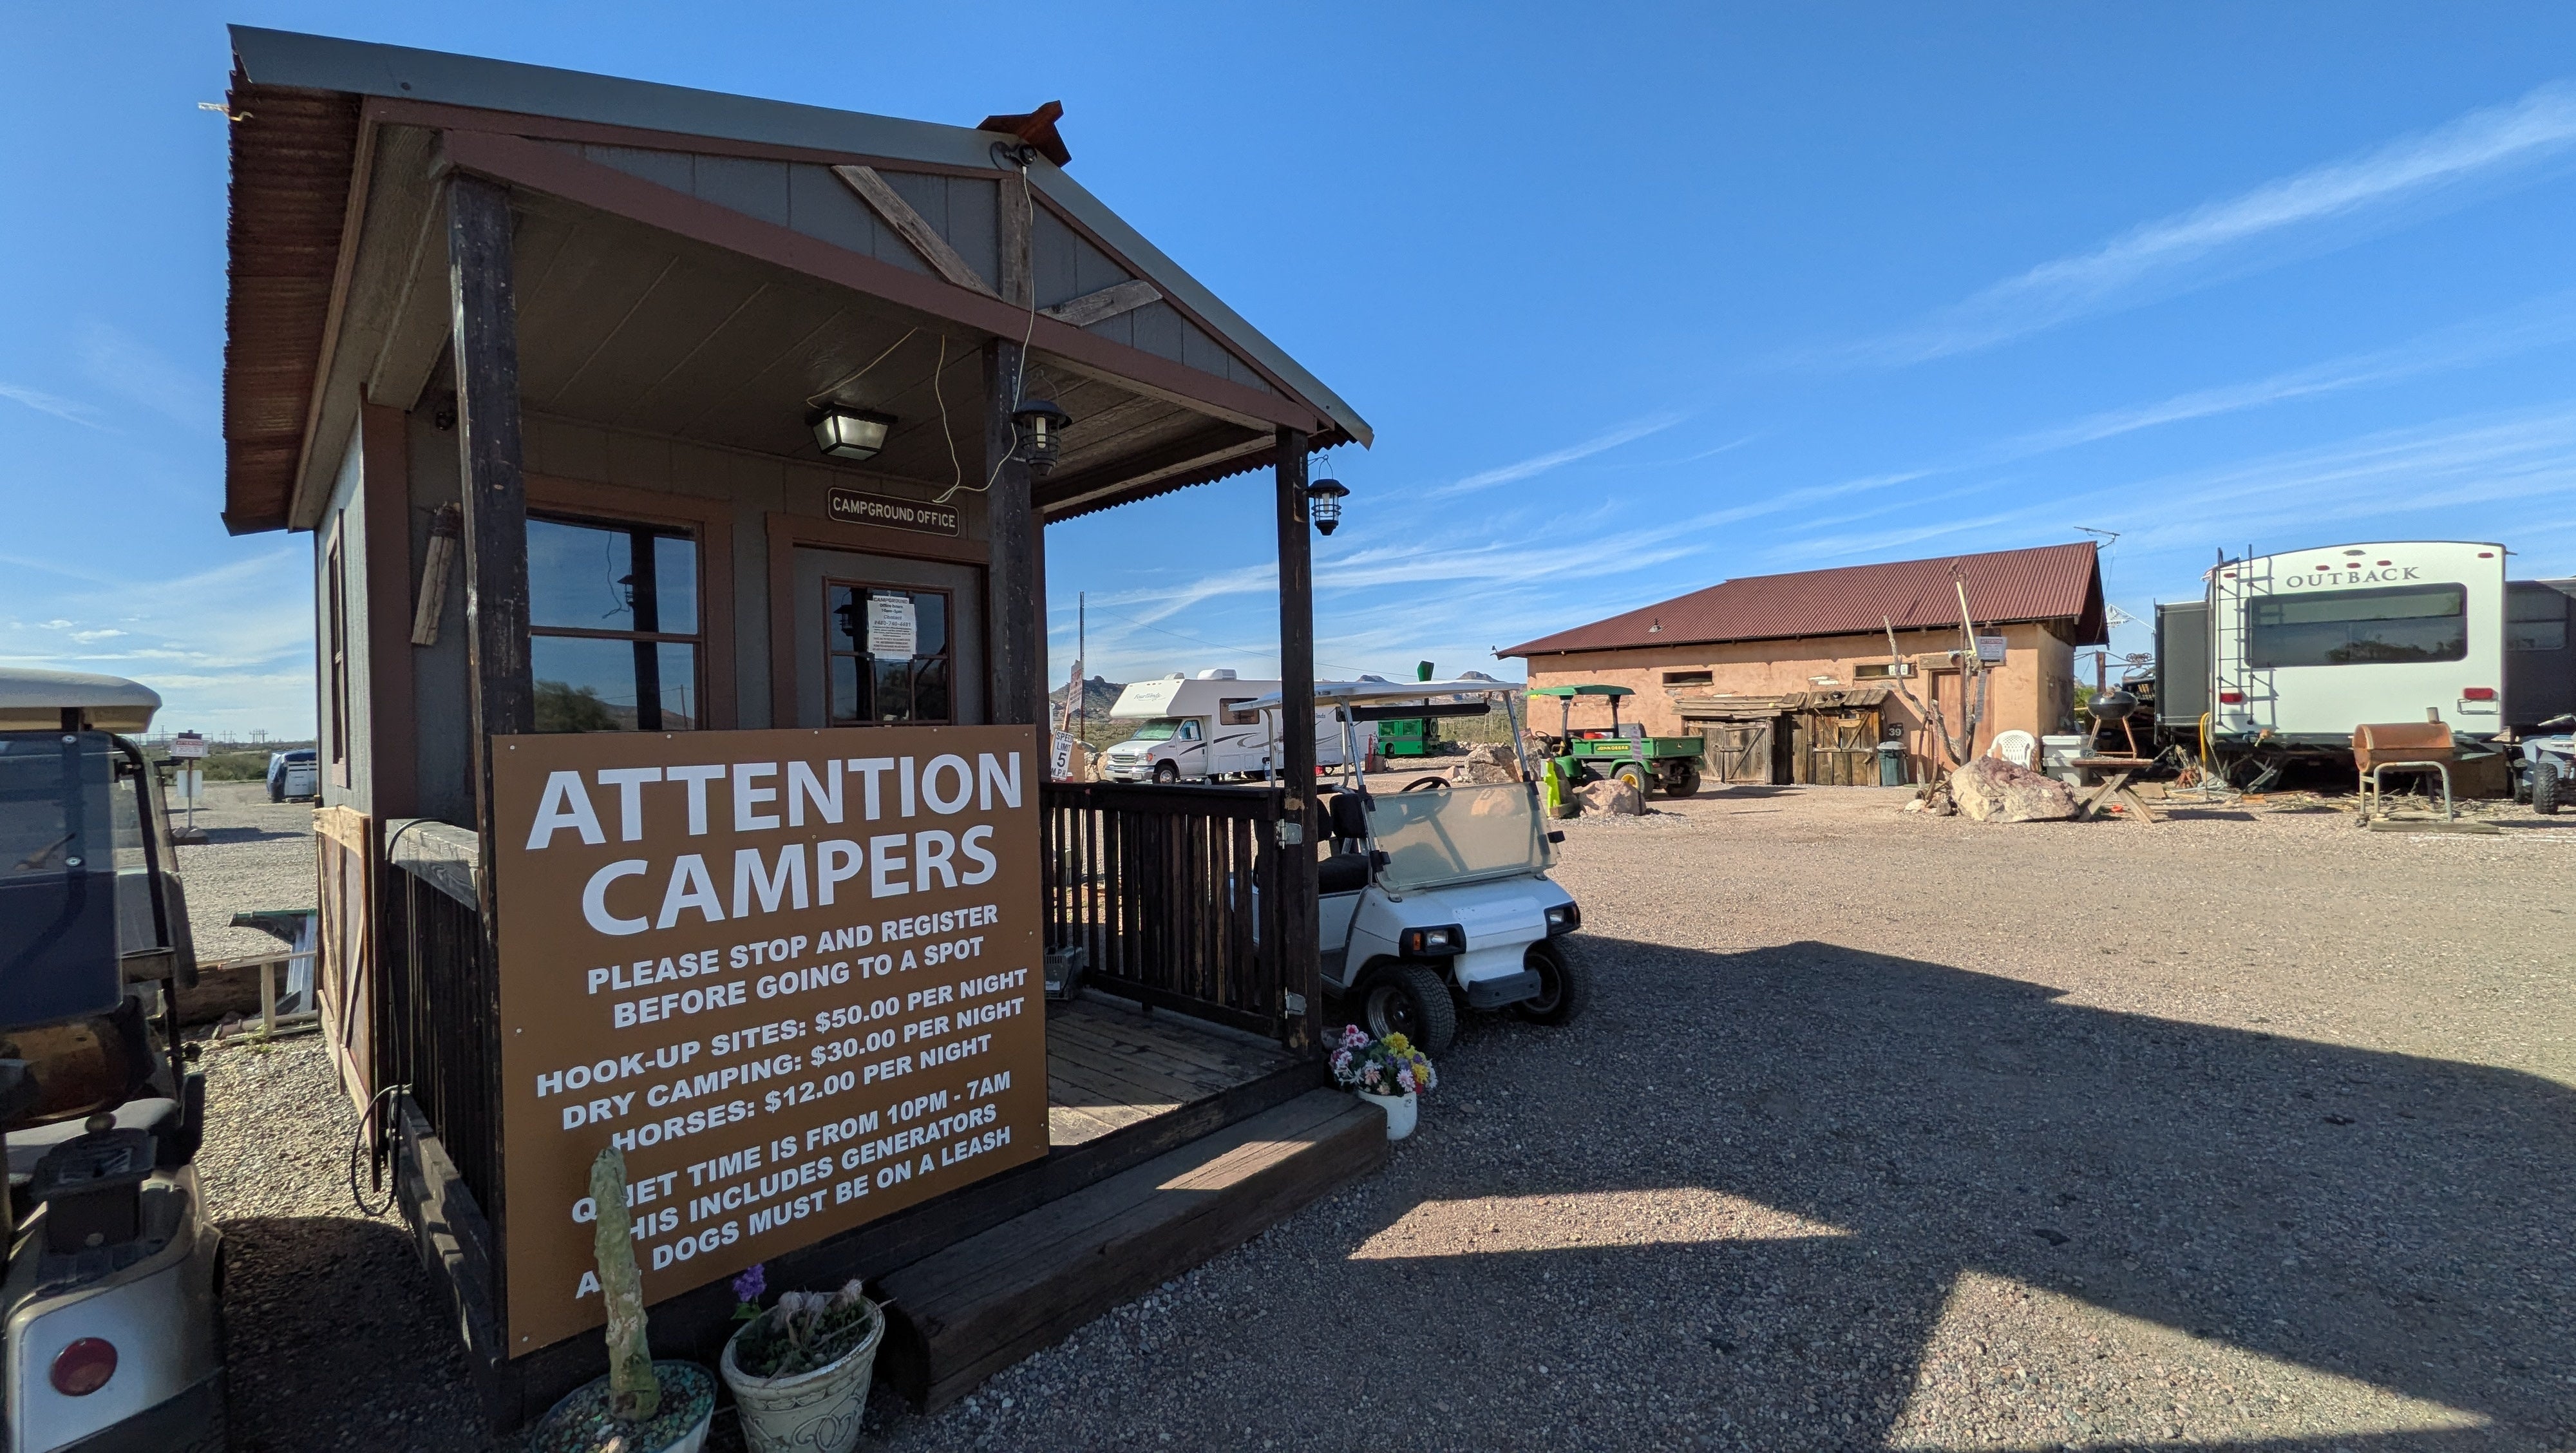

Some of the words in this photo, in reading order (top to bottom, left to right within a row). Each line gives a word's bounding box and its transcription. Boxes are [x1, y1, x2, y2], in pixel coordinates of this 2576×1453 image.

[833, 497, 914, 522] CAMPGROUND
[916, 509, 956, 528] OFFICE
[2286, 566, 2421, 588] OUTBACK
[1056, 732, 1074, 743] SPEED
[1056, 741, 1071, 752] LIMIT
[1057, 752, 1067, 768] 5
[1888, 728, 1902, 736] 39
[525, 752, 1021, 850] ATTENTION
[582, 824, 997, 936] CAMPERS
[588, 949, 719, 994] PLEASE
[730, 935, 808, 969] STOP
[816, 925, 873, 954] AND
[882, 904, 998, 943] REGISTER
[614, 980, 746, 1029] BEFORE
[756, 962, 849, 999] GOING
[857, 954, 893, 979] TO
[900, 949, 918, 972] A
[924, 936, 984, 966] SPOT
[537, 1041, 701, 1097] HOOK-UP
[711, 1019, 806, 1056] SITES:
[815, 996, 900, 1034] $50.00
[907, 985, 954, 1011] PER
[960, 968, 1028, 1000] NIGHT
[563, 1091, 636, 1130] DRY
[647, 1054, 801, 1107] CAMPING:
[810, 1029, 896, 1068] $30.00
[904, 1016, 950, 1043] PER
[957, 996, 1025, 1030] NIGHT
[612, 1100, 755, 1151] HORSES:
[764, 1070, 855, 1114] $12.00
[864, 1056, 913, 1085] PER
[920, 1034, 992, 1069] NIGHT
[572, 1171, 677, 1223] QIET
[687, 1146, 761, 1187] TIME
[771, 1135, 797, 1163] IS
[806, 1110, 878, 1152] FROM
[887, 1090, 947, 1125] 10PM
[967, 1070, 1010, 1100] 7AM
[630, 1207, 679, 1240] HIS
[690, 1156, 833, 1222] INCLUDES
[841, 1103, 996, 1170] GENERATORS
[653, 1220, 739, 1271] DOGS
[749, 1188, 828, 1236] MUST
[836, 1174, 869, 1204] BE
[876, 1160, 911, 1188] ON
[918, 1153, 935, 1175] A
[942, 1126, 1010, 1167] LEASH
